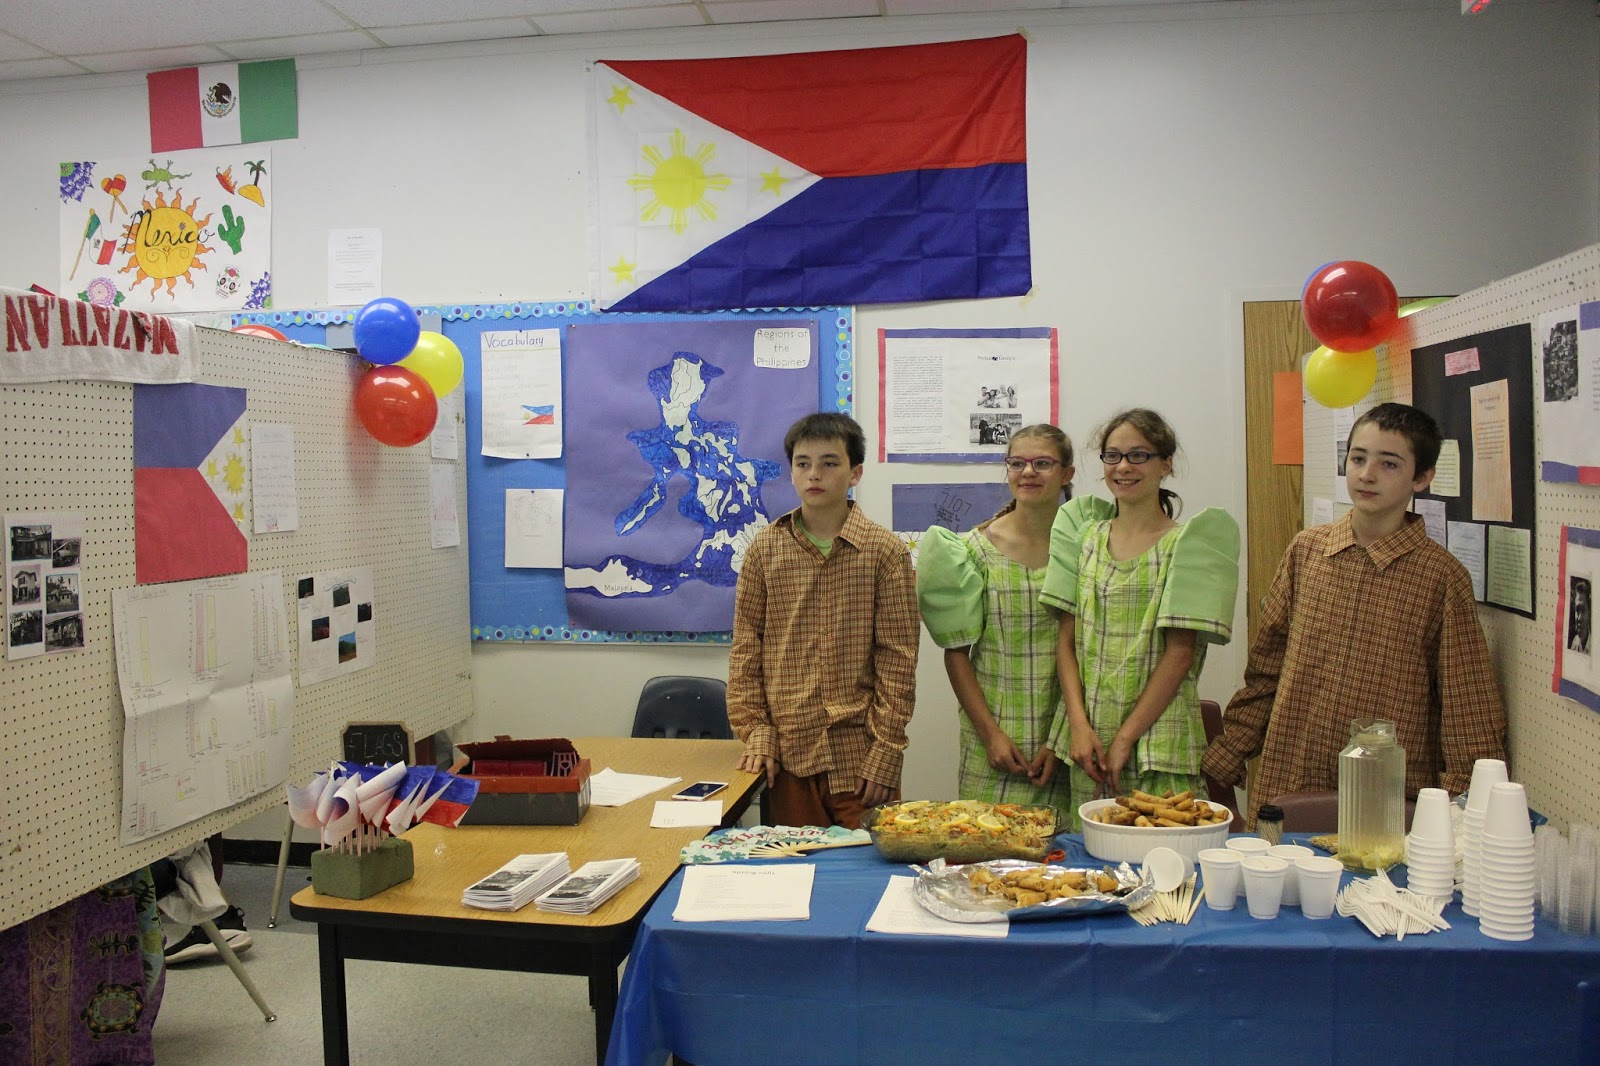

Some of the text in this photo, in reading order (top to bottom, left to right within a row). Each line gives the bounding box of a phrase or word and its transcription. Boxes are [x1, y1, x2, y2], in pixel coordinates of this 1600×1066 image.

[122, 209, 216, 254] Mexico
[484, 331, 544, 348] Vocabulary
[757, 330, 809, 342] Regions of
[773, 343, 790, 353] the
[756, 356, 807, 367] Philippines
[940, 491, 972, 516] 7107
[348, 731, 403, 759] FLAGS
